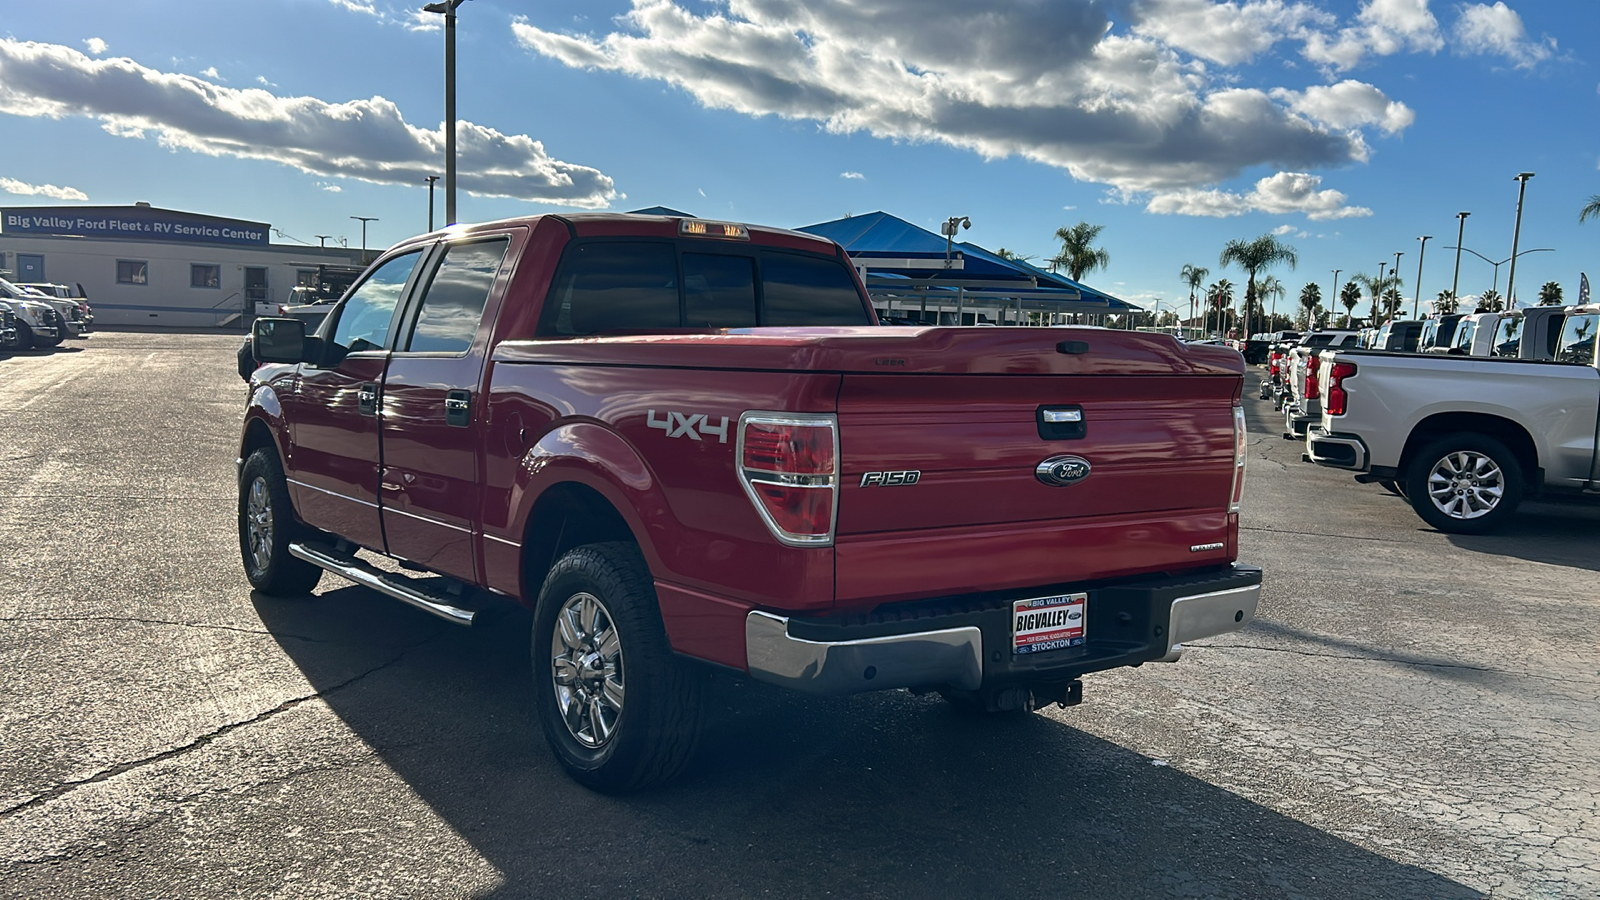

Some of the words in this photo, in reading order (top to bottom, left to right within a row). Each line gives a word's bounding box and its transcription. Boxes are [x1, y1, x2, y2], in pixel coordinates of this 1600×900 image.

[8, 215, 30, 228] Big
[33, 216, 74, 230] Valley
[77, 219, 106, 231] Ford
[109, 220, 142, 232] Fleet
[144, 224, 151, 232] &
[154, 223, 172, 233] RV
[174, 224, 220, 238] Service
[221, 228, 262, 241] Center
[1060, 463, 1084, 478] Ford
[860, 470, 921, 488] F-150
[1046, 597, 1070, 605] VALLEY
[1032, 640, 1070, 651] STOCKTON
